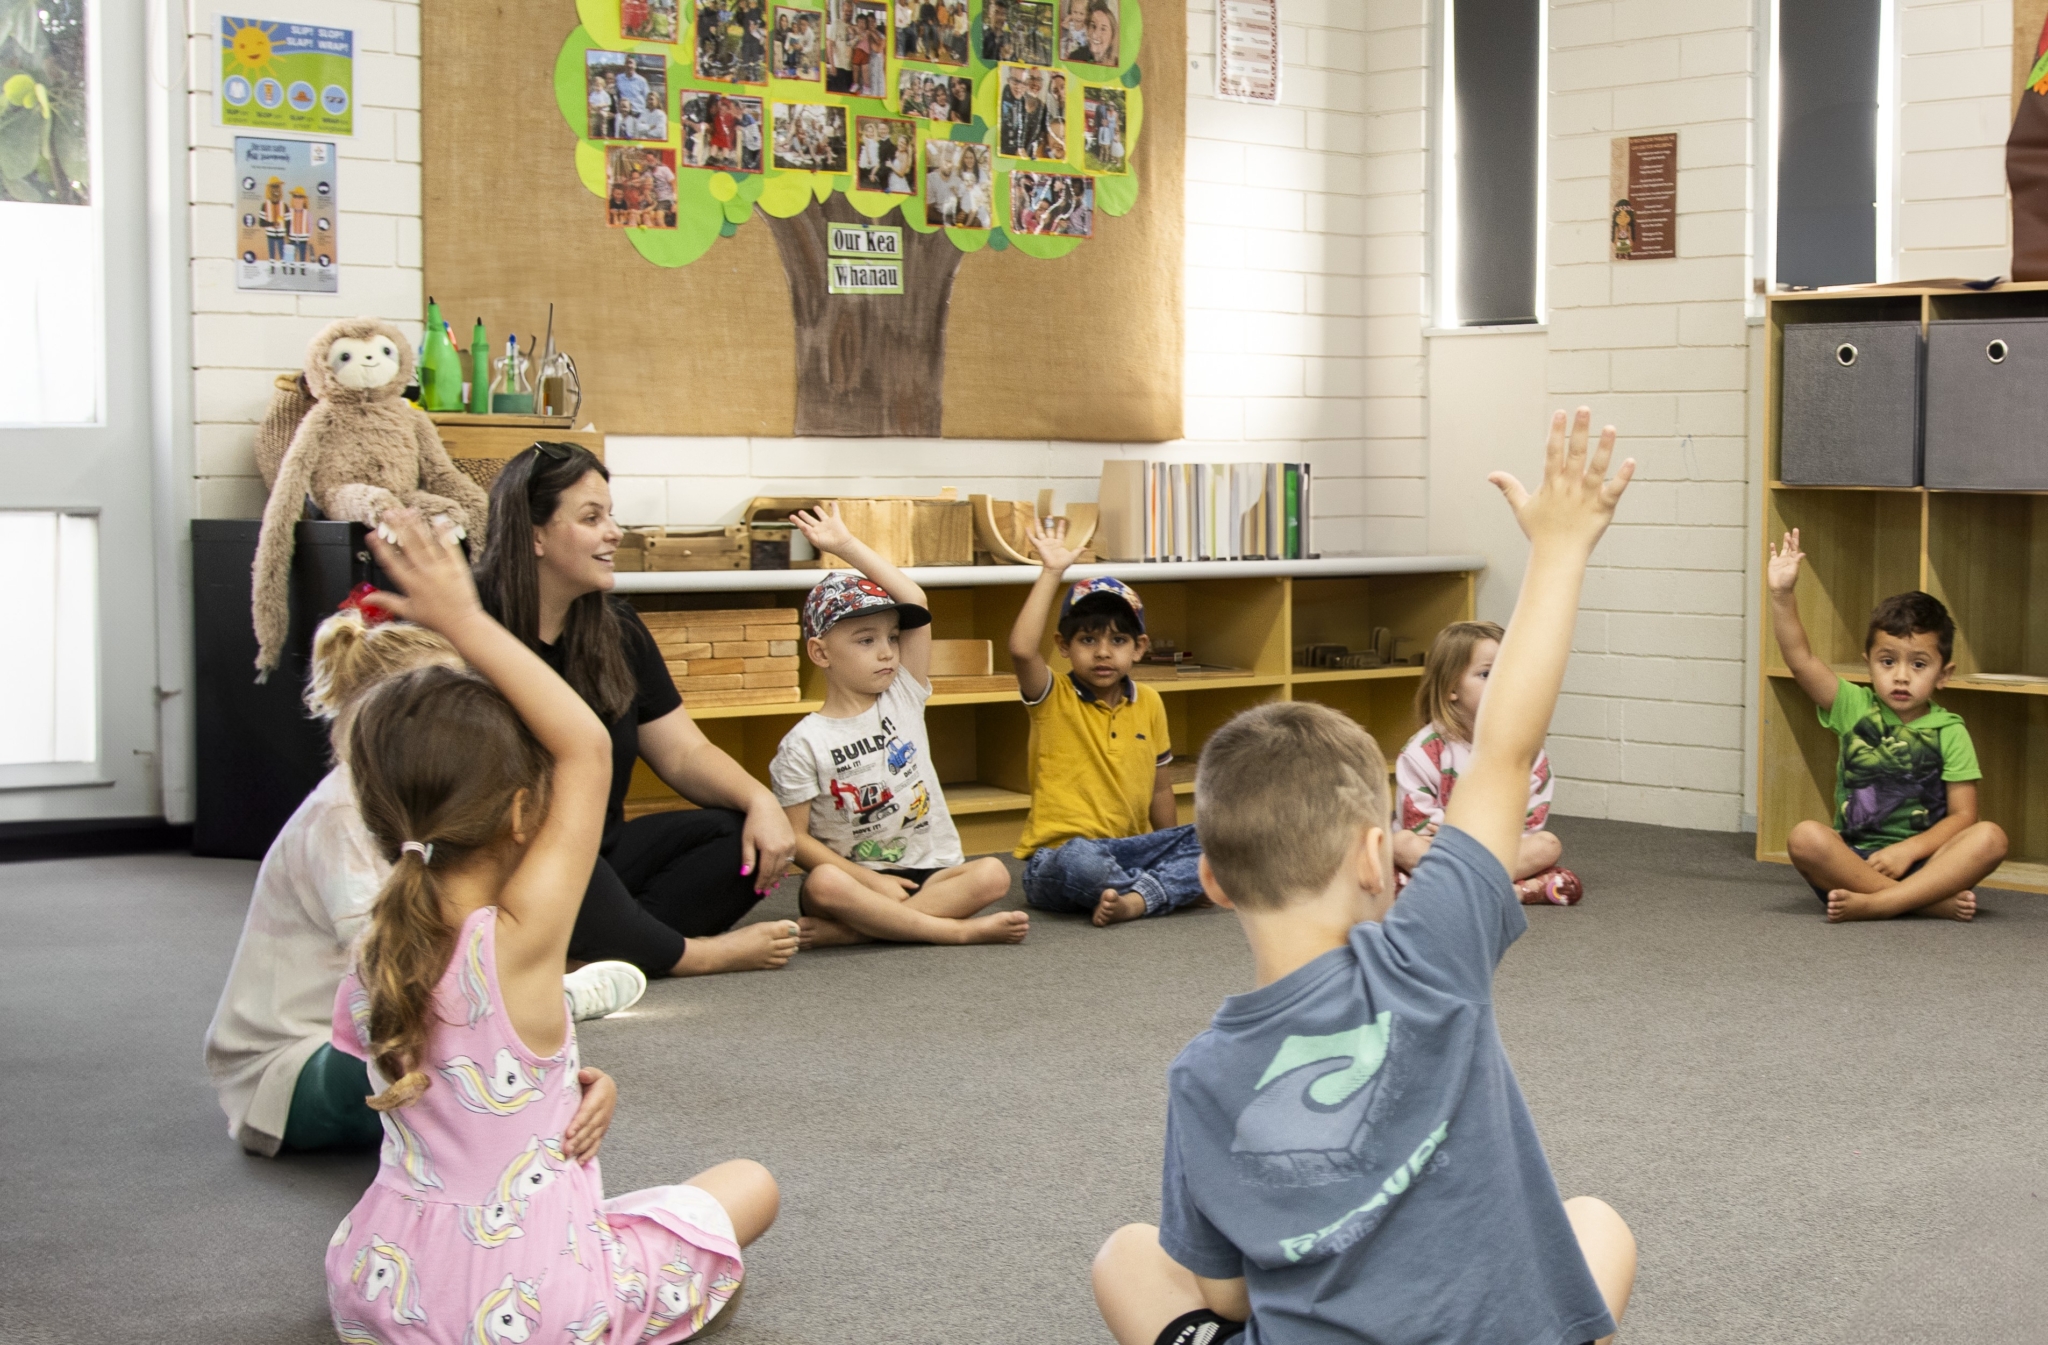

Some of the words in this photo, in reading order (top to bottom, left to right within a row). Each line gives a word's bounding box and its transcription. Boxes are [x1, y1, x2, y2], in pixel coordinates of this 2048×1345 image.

[285, 37, 314, 48] SLAP!
[290, 25, 314, 36] SLIP!
[317, 28, 345, 40] SLOP!
[834, 229, 861, 251] Our
[866, 231, 896, 253] Kea
[835, 265, 898, 286] Whanau
[830, 734, 885, 766] BUILD
